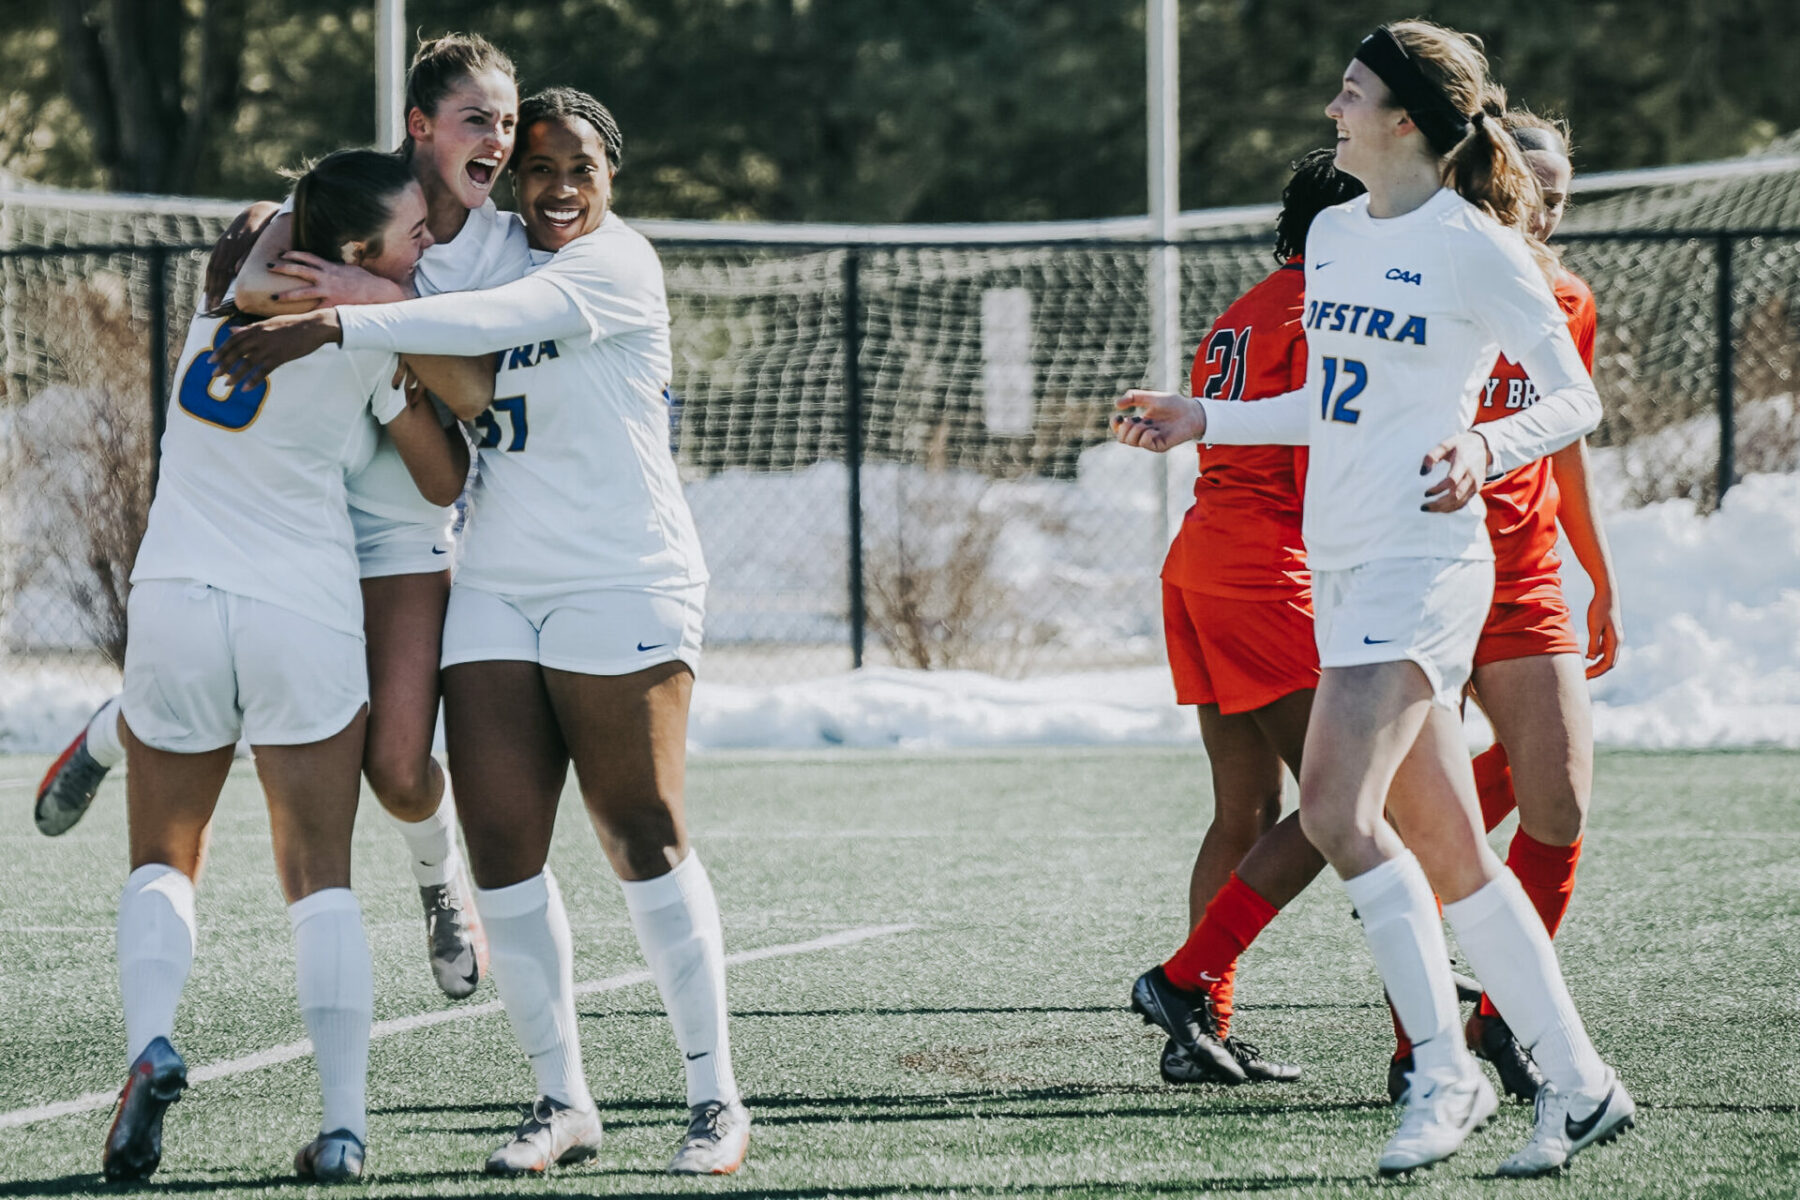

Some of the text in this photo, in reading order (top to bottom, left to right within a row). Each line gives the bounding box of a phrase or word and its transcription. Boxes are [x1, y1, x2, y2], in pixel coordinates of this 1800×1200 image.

[1385, 268, 1422, 286] CAA
[1203, 326, 1253, 401] 21
[1321, 356, 1369, 424] 12
